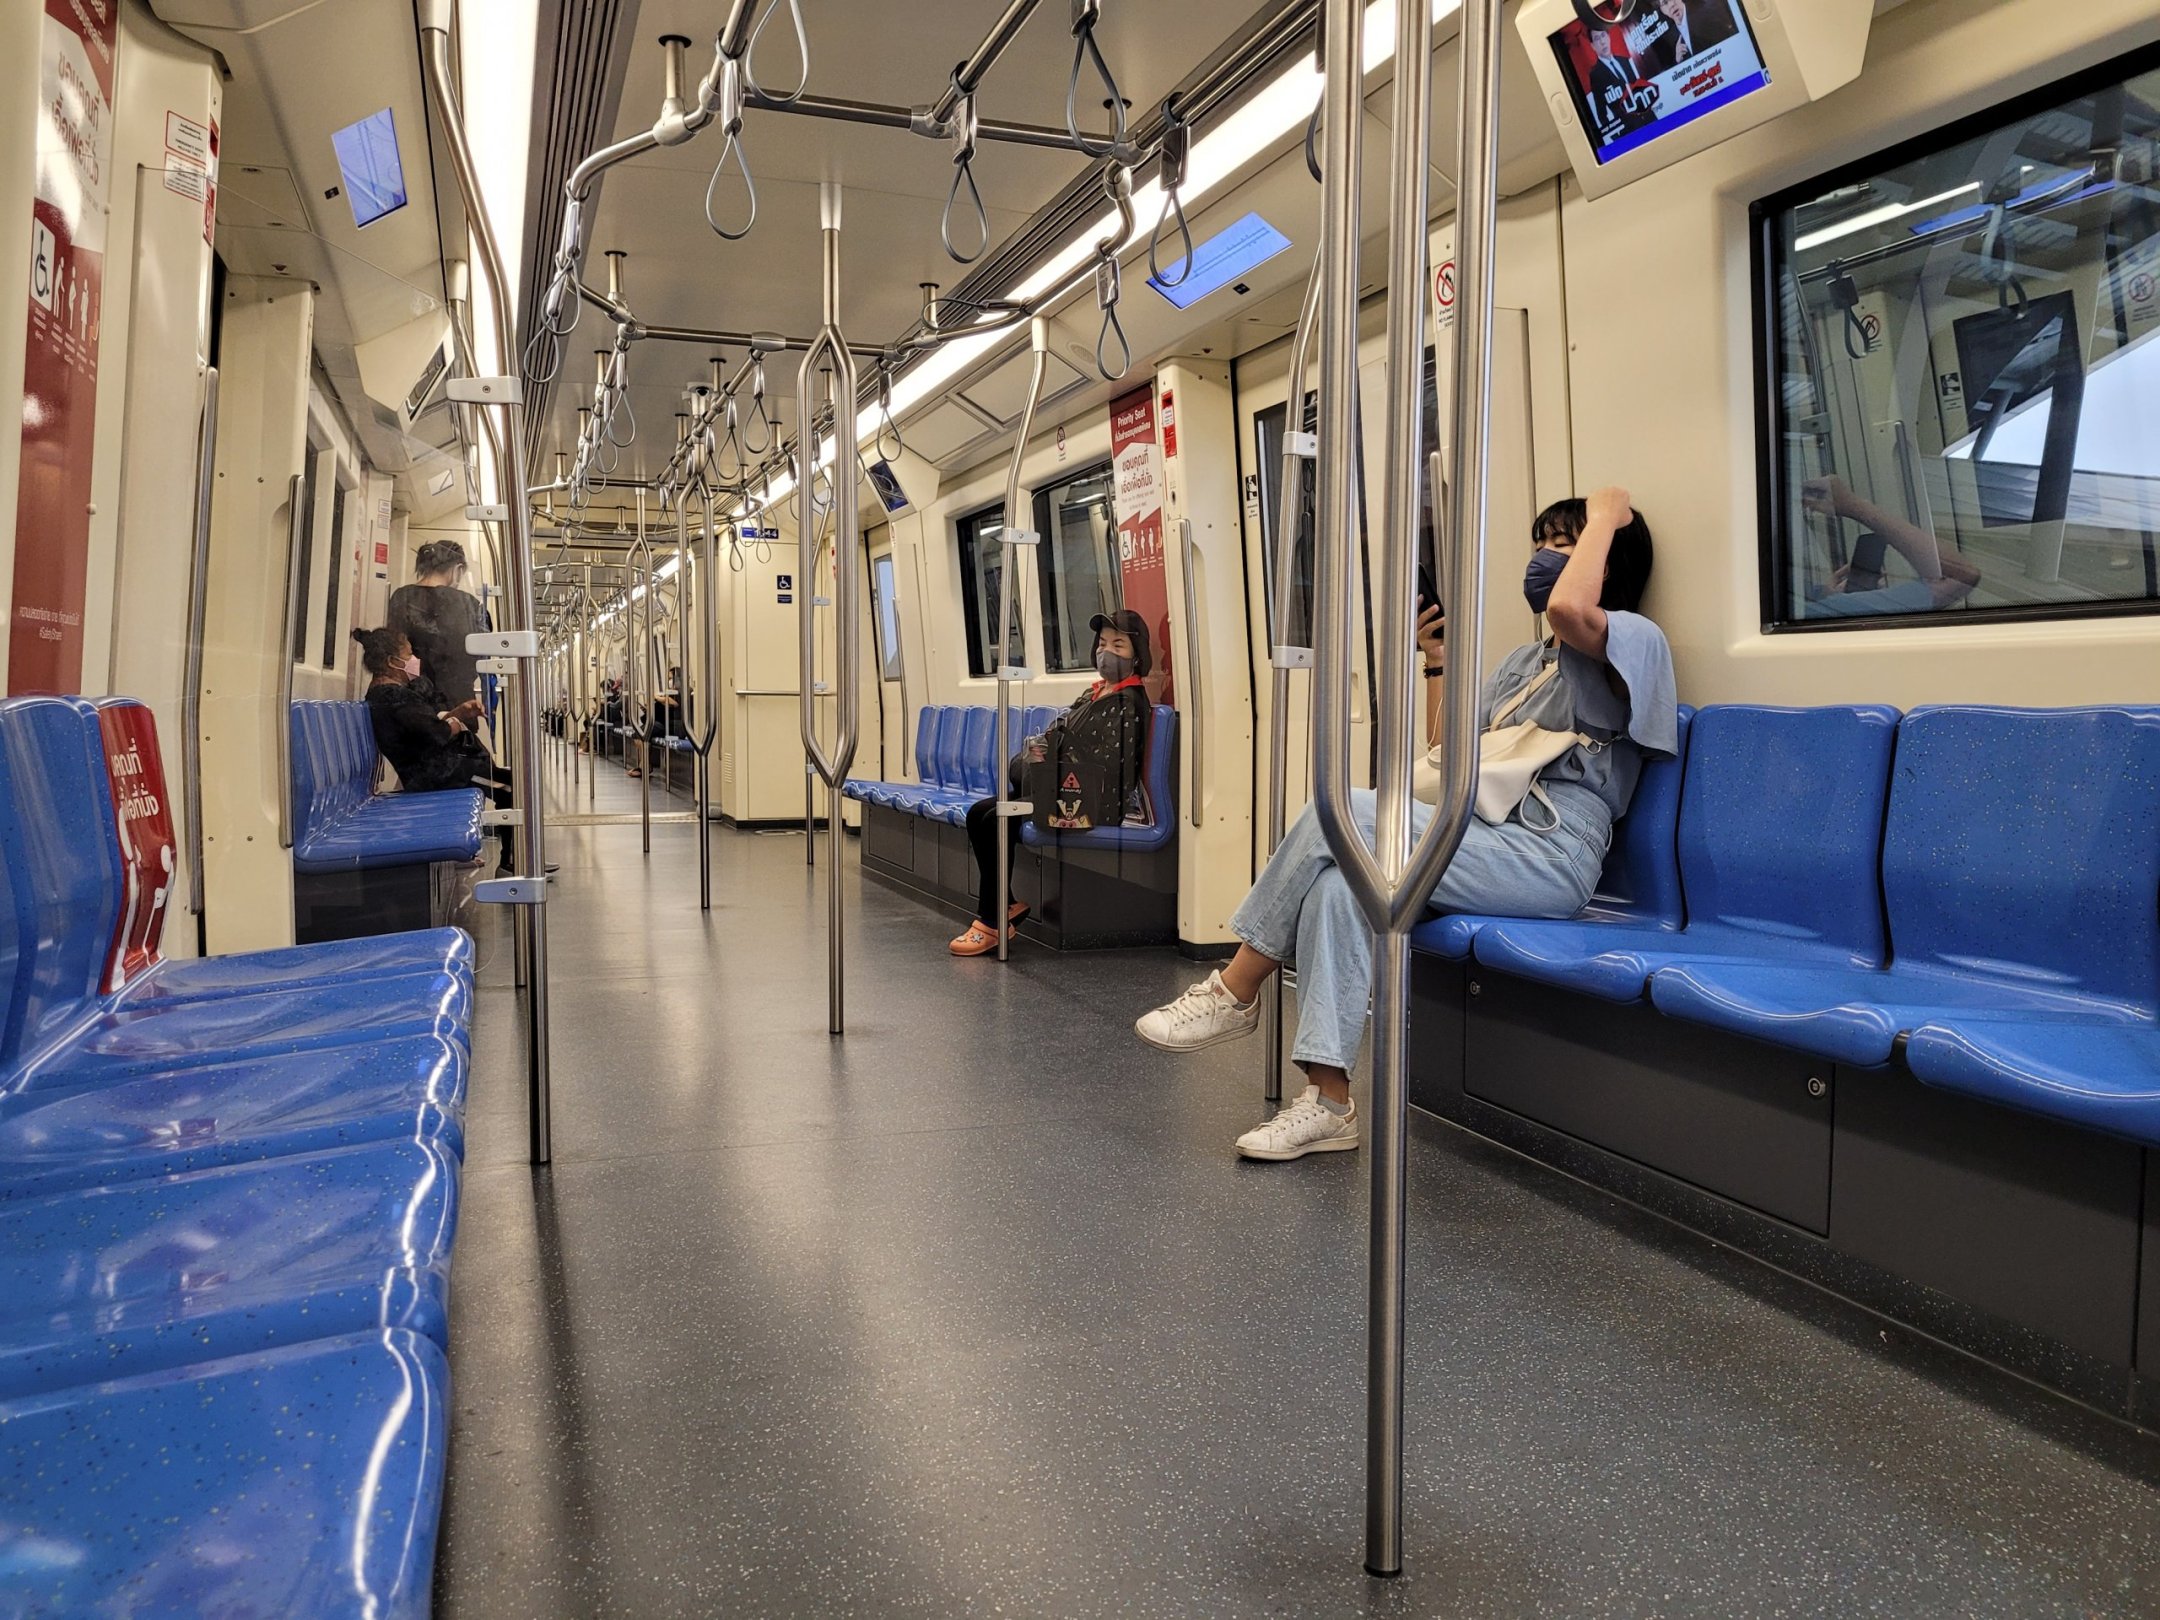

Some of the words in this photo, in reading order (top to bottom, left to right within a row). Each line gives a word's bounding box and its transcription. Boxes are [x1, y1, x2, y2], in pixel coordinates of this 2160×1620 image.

[1623, 83, 1657, 113] ปาก
[1117, 411, 1134, 428] Priority
[1134, 406, 1146, 421] Seat
[1122, 445, 1149, 472] ขอบคุณที่
